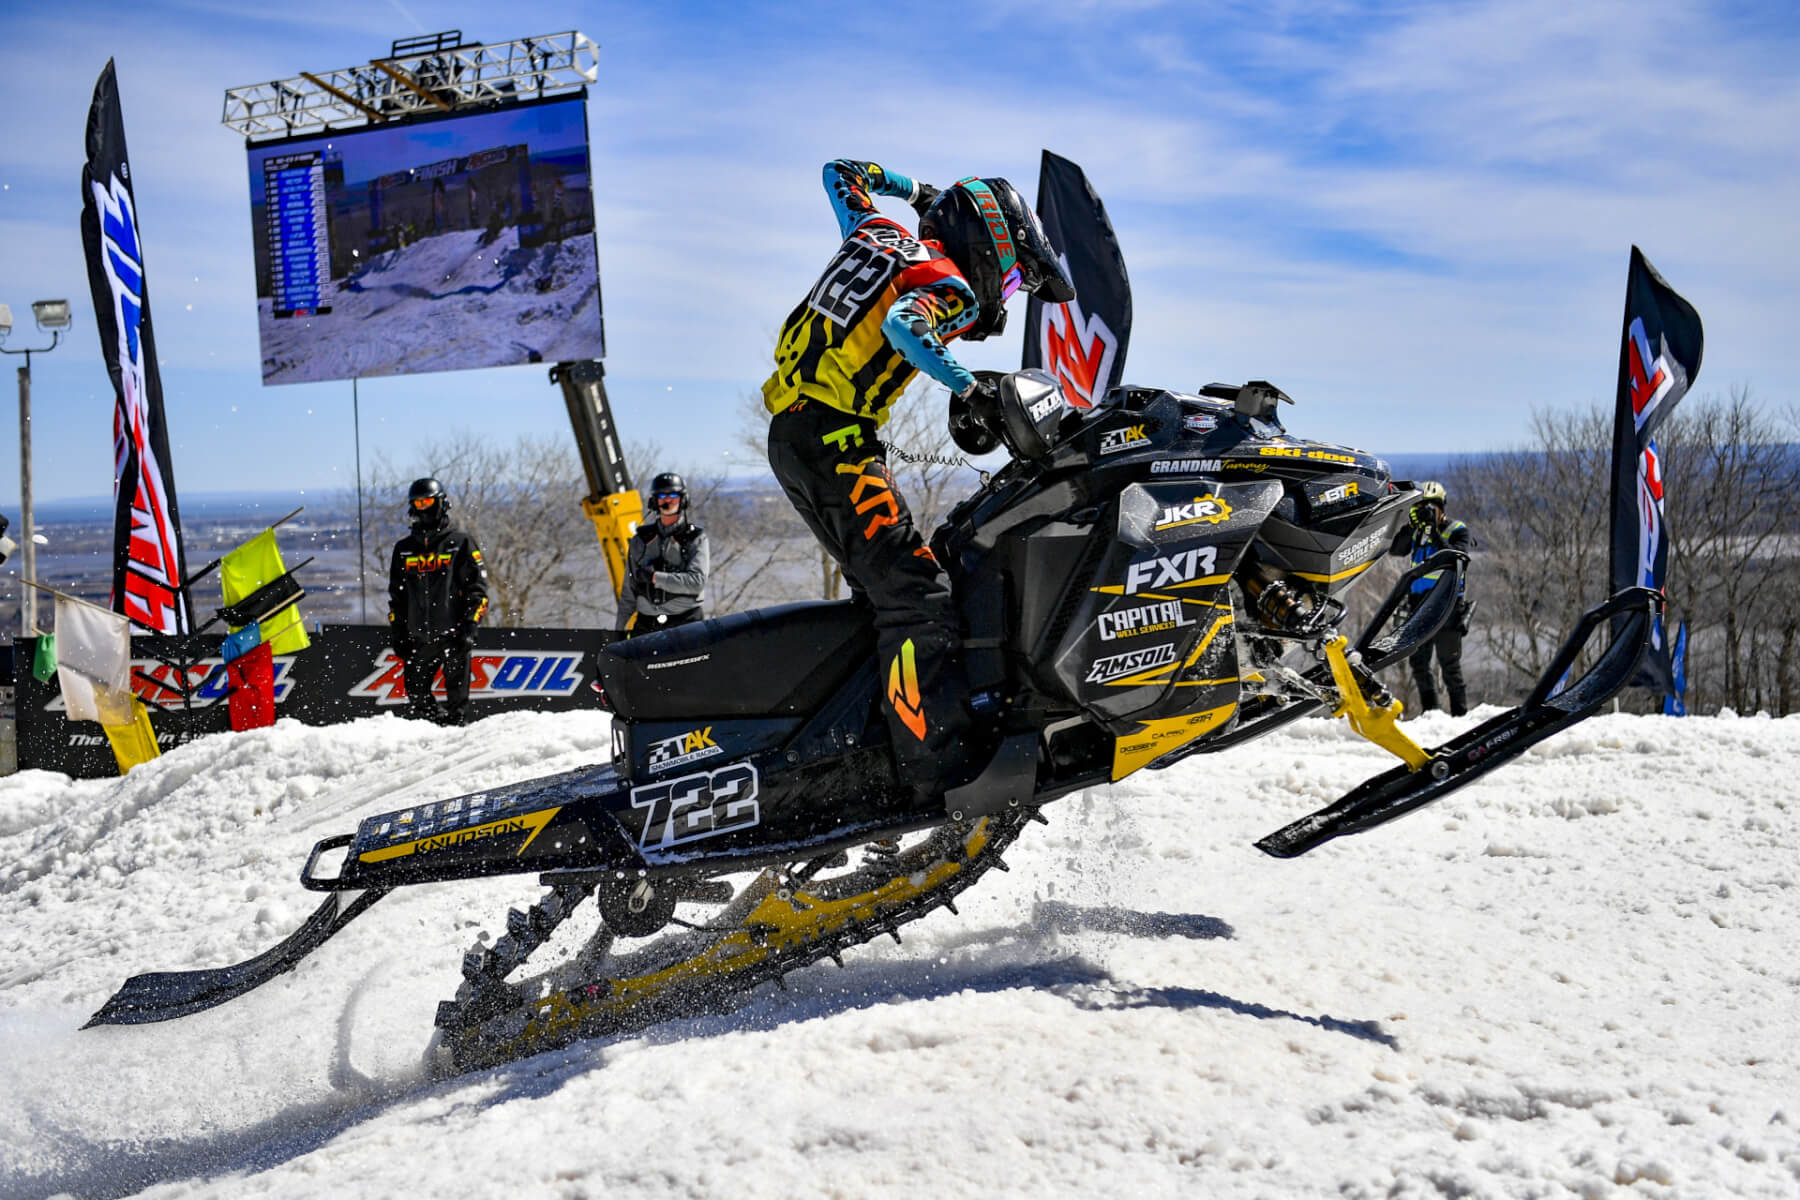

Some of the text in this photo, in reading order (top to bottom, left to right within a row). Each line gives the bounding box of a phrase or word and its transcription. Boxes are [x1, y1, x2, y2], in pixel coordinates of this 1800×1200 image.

[413, 159, 458, 183] FINISH
[977, 193, 1015, 259] RIDE
[822, 423, 899, 541] FXR
[1151, 459, 1222, 474] GRANDMA
[1325, 481, 1359, 502] BTR
[1156, 501, 1217, 526] JKR
[405, 552, 452, 572] FXR
[1125, 546, 1218, 595] FXR
[1098, 600, 1197, 641] CAPITAL
[1116, 621, 1175, 639] WELL SERVICES
[352, 650, 583, 705] ASOIL
[1085, 643, 1176, 684] AMSOIL
[68, 734, 103, 747] The
[157, 734, 177, 744] in
[631, 762, 760, 853] 722
[414, 819, 525, 853] KNUDSON
